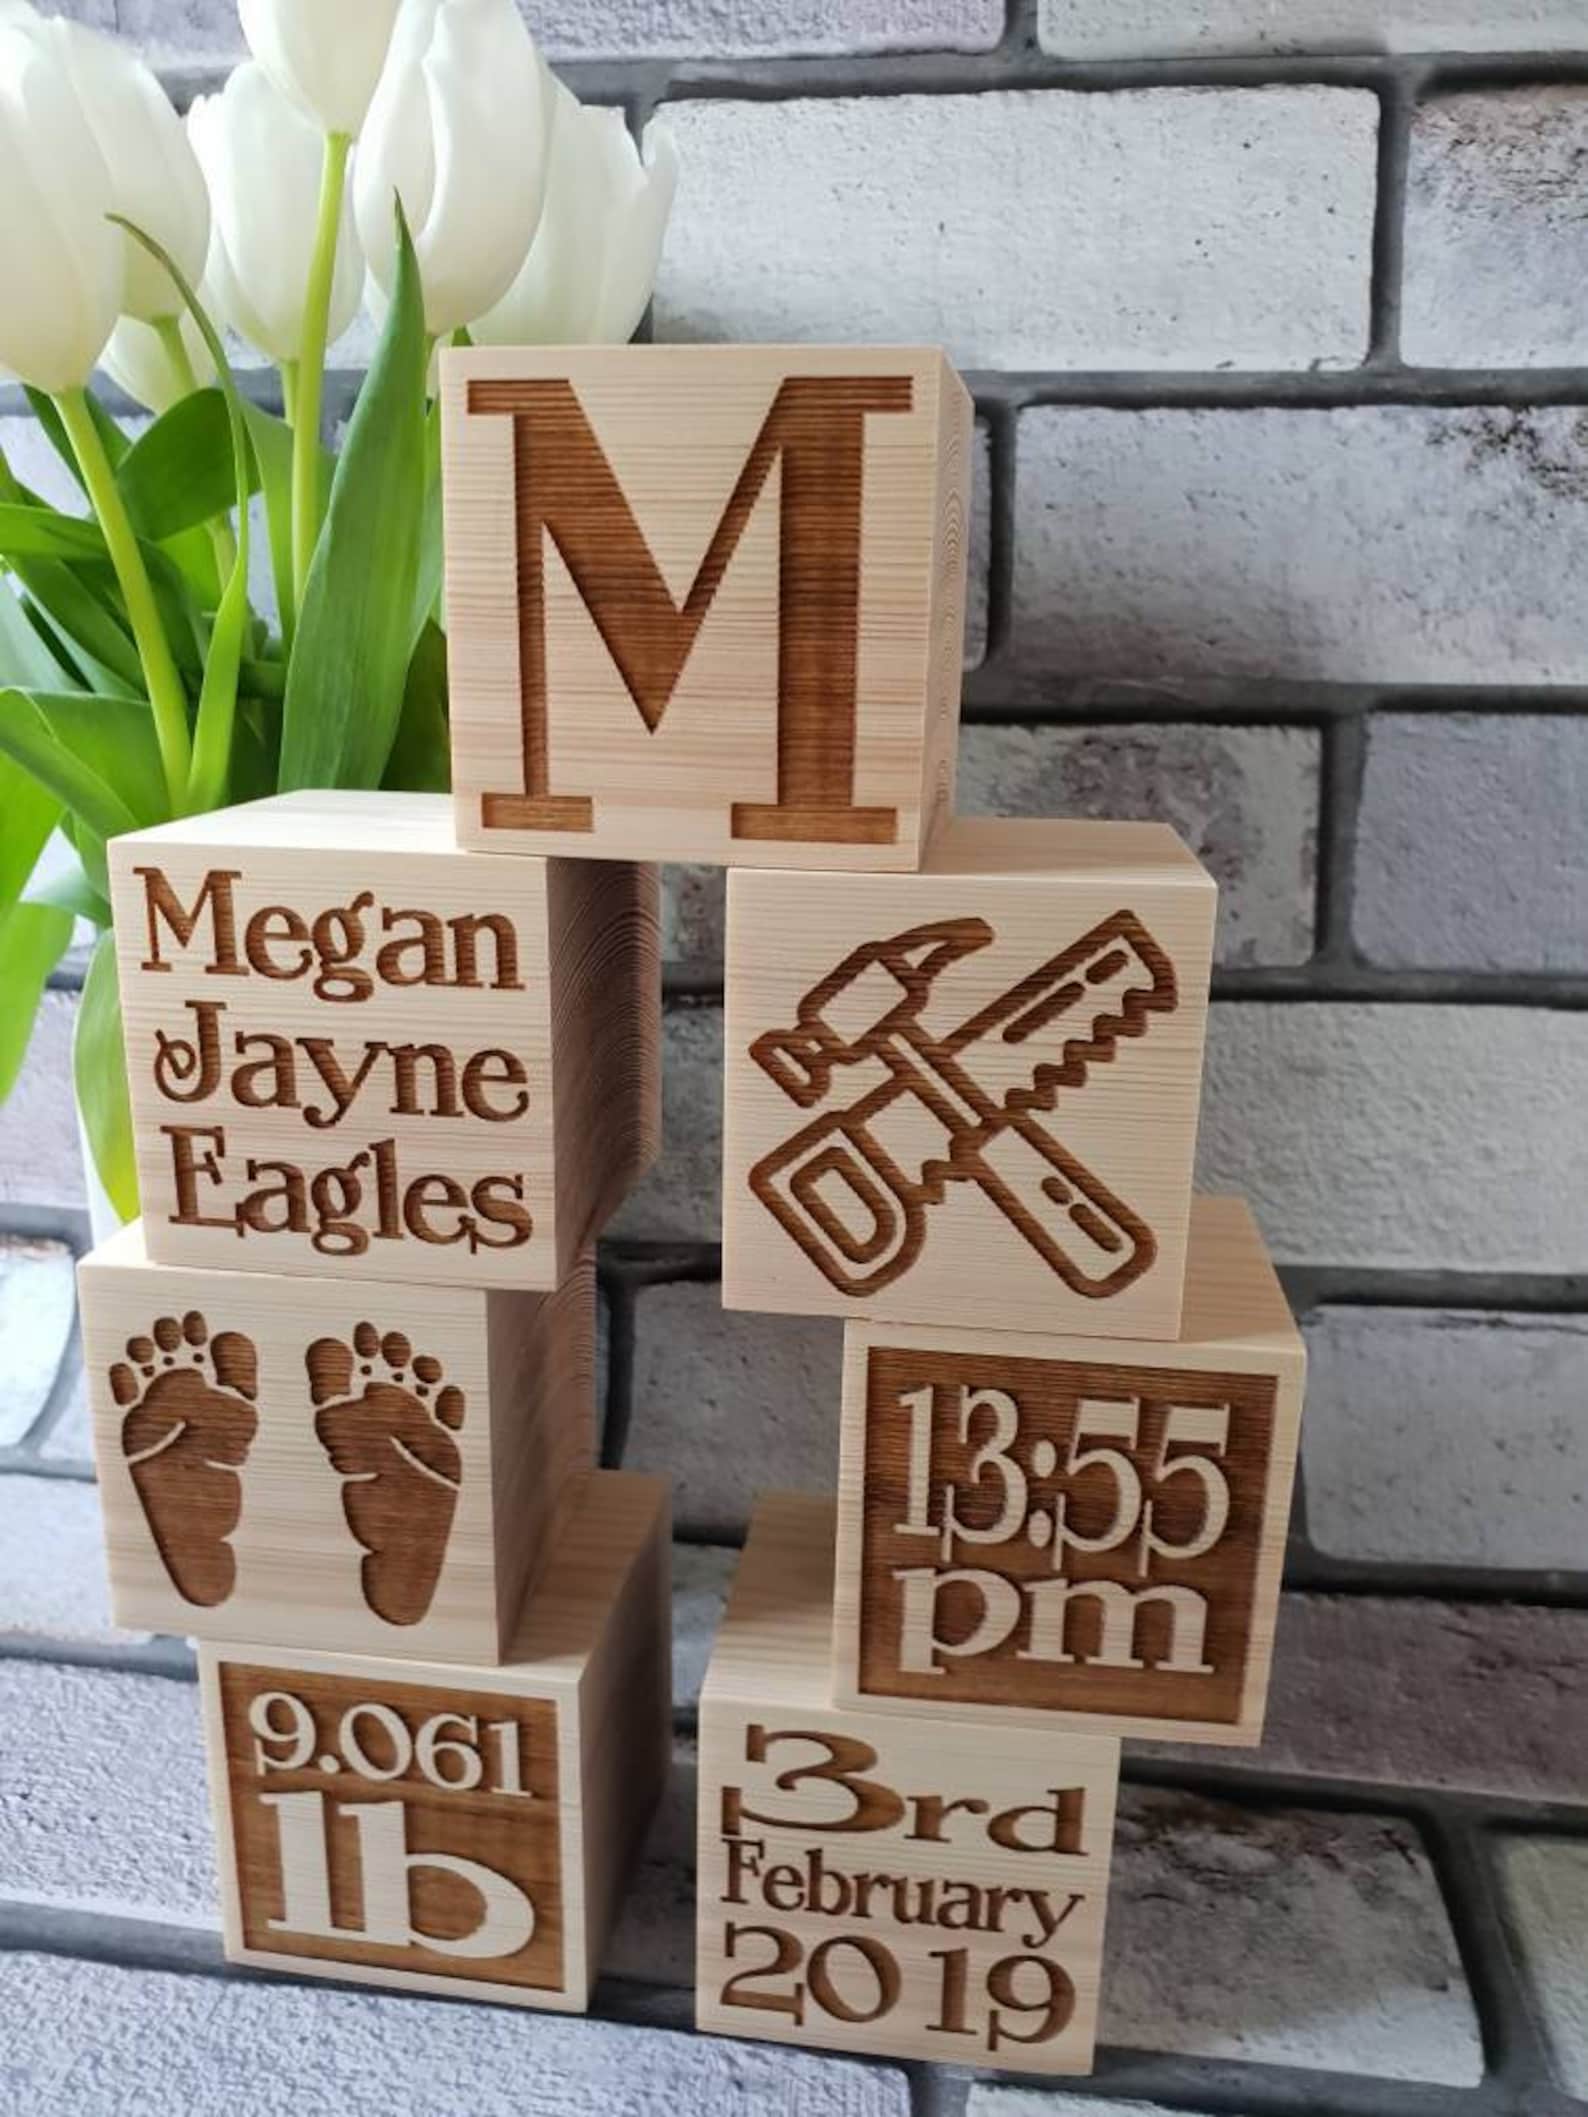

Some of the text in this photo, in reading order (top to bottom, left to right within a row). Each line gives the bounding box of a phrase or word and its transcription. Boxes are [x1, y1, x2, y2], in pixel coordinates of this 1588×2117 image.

[467, 376, 913, 843] M
[133, 866, 525, 1002] Megan
[154, 1000, 529, 1128] Jayne
[160, 1125, 532, 1256] Eagles
[894, 1385, 1231, 1577] 13:55
[892, 1566, 1215, 1676] pm
[248, 1691, 531, 1798] 9.061
[721, 1724, 1088, 1857] 3rd
[258, 1791, 535, 1957] lb
[720, 1838, 1085, 1949] February
[720, 1921, 1076, 2051] 2019
